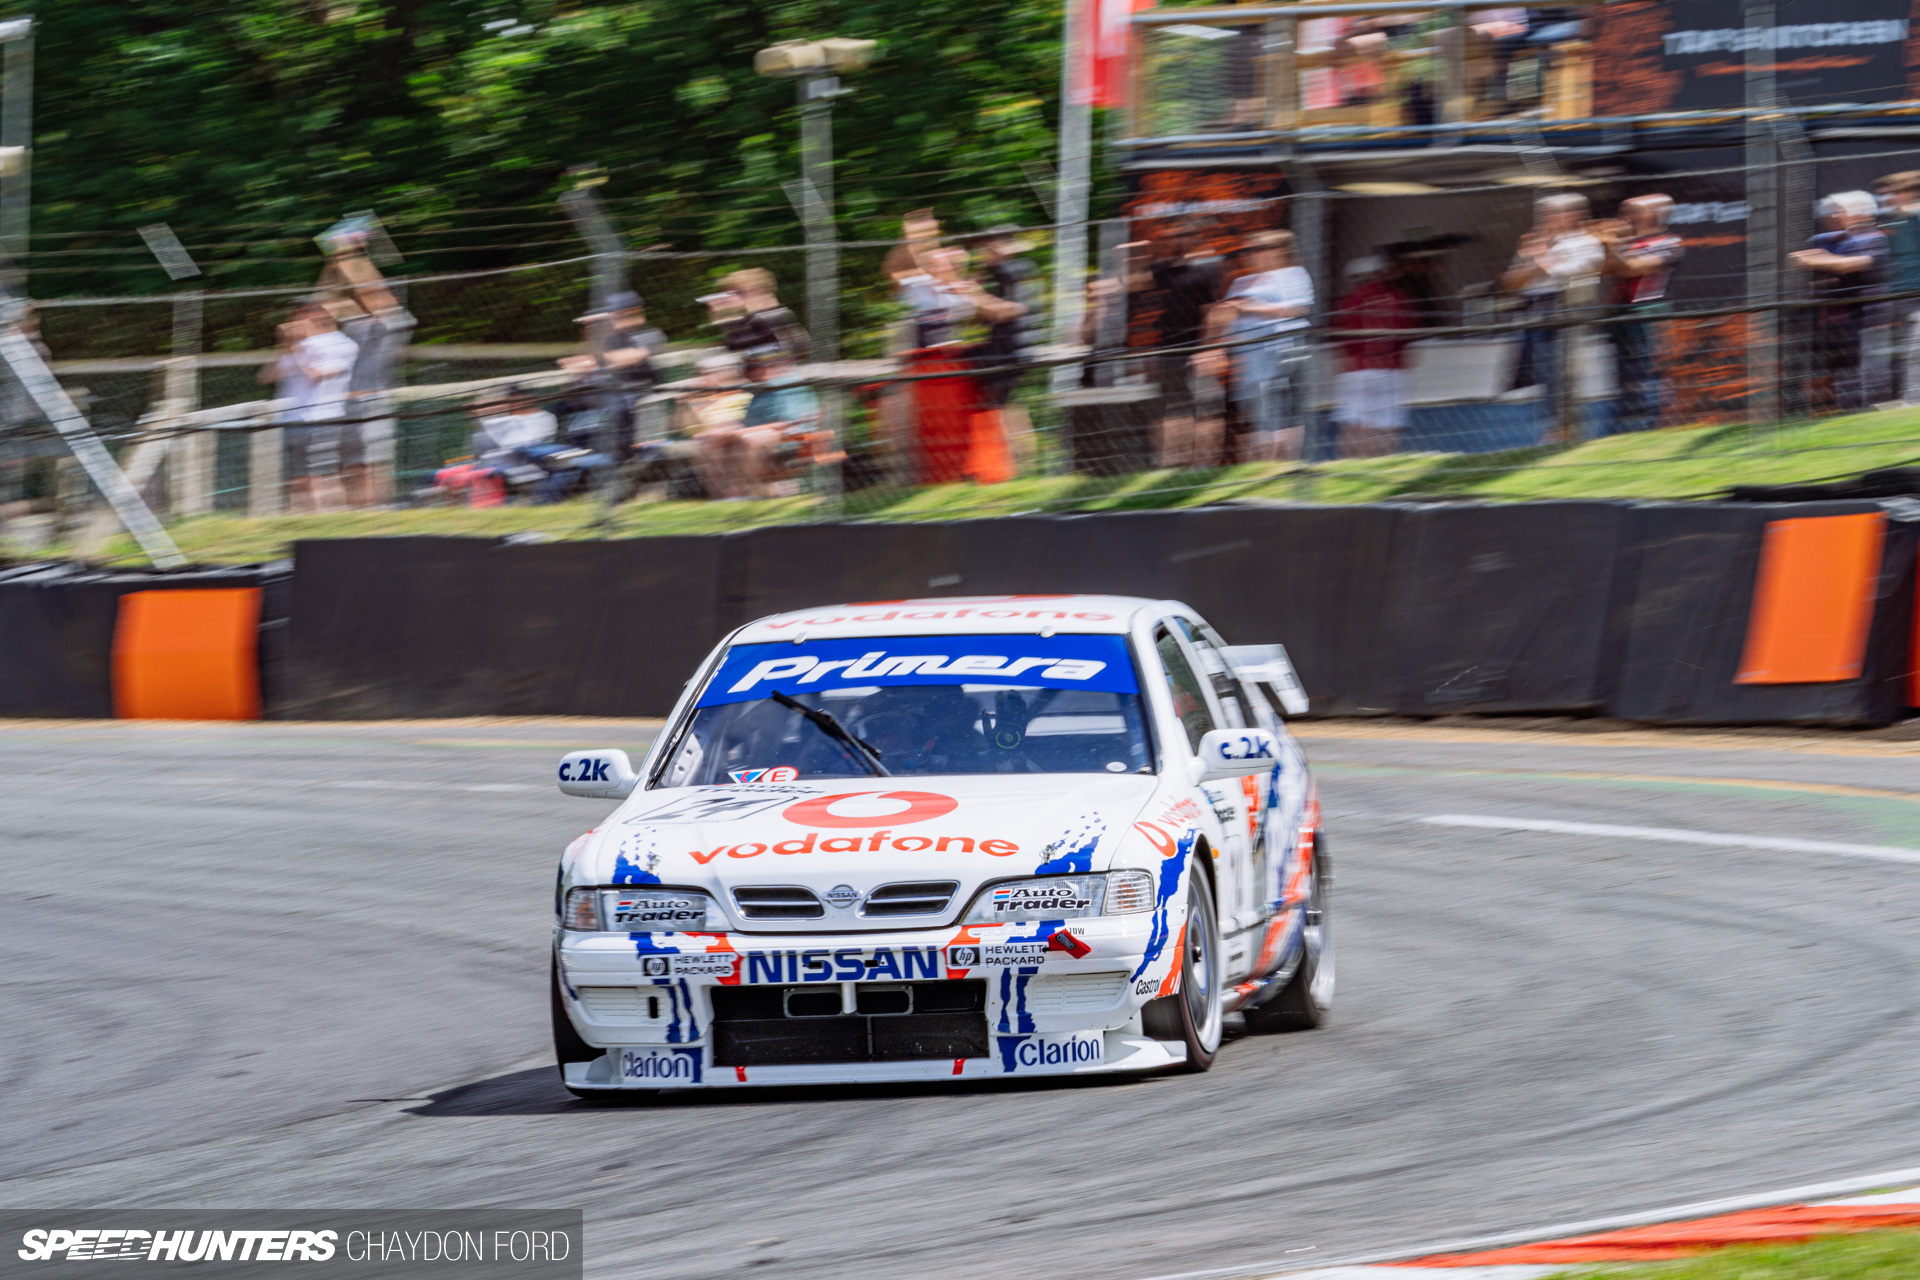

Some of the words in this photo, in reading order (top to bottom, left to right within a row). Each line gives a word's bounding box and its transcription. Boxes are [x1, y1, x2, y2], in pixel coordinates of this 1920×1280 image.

[766, 608, 1116, 630] vodafone
[727, 651, 1107, 694] Primera
[558, 758, 611, 781] c.2k
[771, 770, 789, 782] E
[688, 830, 1020, 865] vodafone
[1009, 888, 1073, 898] Auto
[631, 899, 690, 910] Auto
[992, 898, 1091, 912] Trader
[614, 909, 706, 923] Trader
[1069, 927, 1085, 935] TOW
[958, 947, 973, 964] hp
[985, 945, 1044, 955] HEWLETT
[674, 954, 732, 964] HEWLETT
[748, 945, 939, 984] NISSAN
[986, 956, 1045, 966] PACKARD
[674, 965, 731, 976] PACKARD
[1135, 976, 1162, 996] Castrol
[1019, 1035, 1100, 1066] Clarion
[622, 1051, 691, 1079] Clarion
